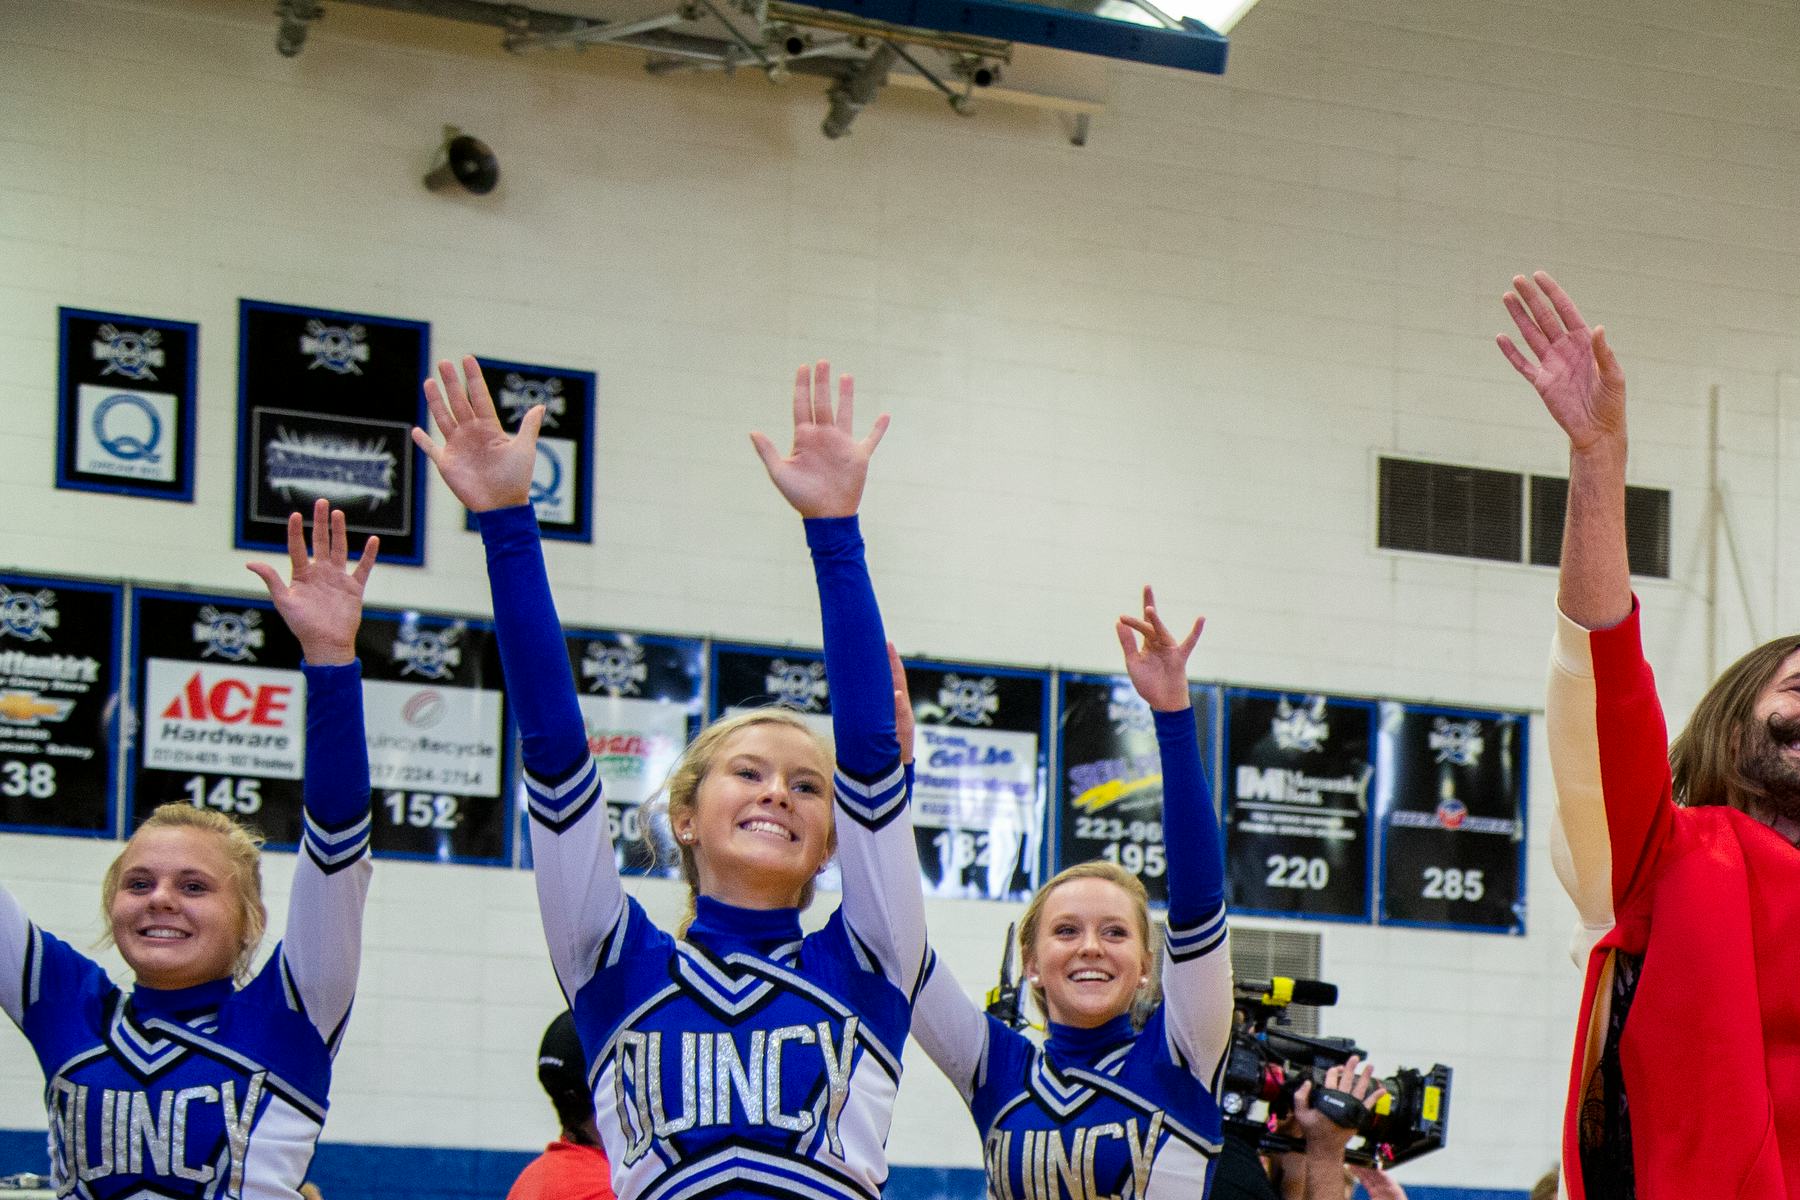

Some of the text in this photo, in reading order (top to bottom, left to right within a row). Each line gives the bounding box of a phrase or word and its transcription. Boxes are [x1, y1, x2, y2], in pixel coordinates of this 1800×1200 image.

[161, 670, 292, 726] ACE
[161, 722, 289, 750] Hardware
[366, 735, 494, 757] uincyRecycle
[184, 775, 262, 814] 145
[385, 791, 459, 829] 152
[1075, 817, 1163, 842] 223-96
[1102, 842, 1166, 878] 195
[1266, 854, 1328, 890] 220
[1422, 866, 1484, 902] 285
[616, 1017, 858, 1168] QUINCY
